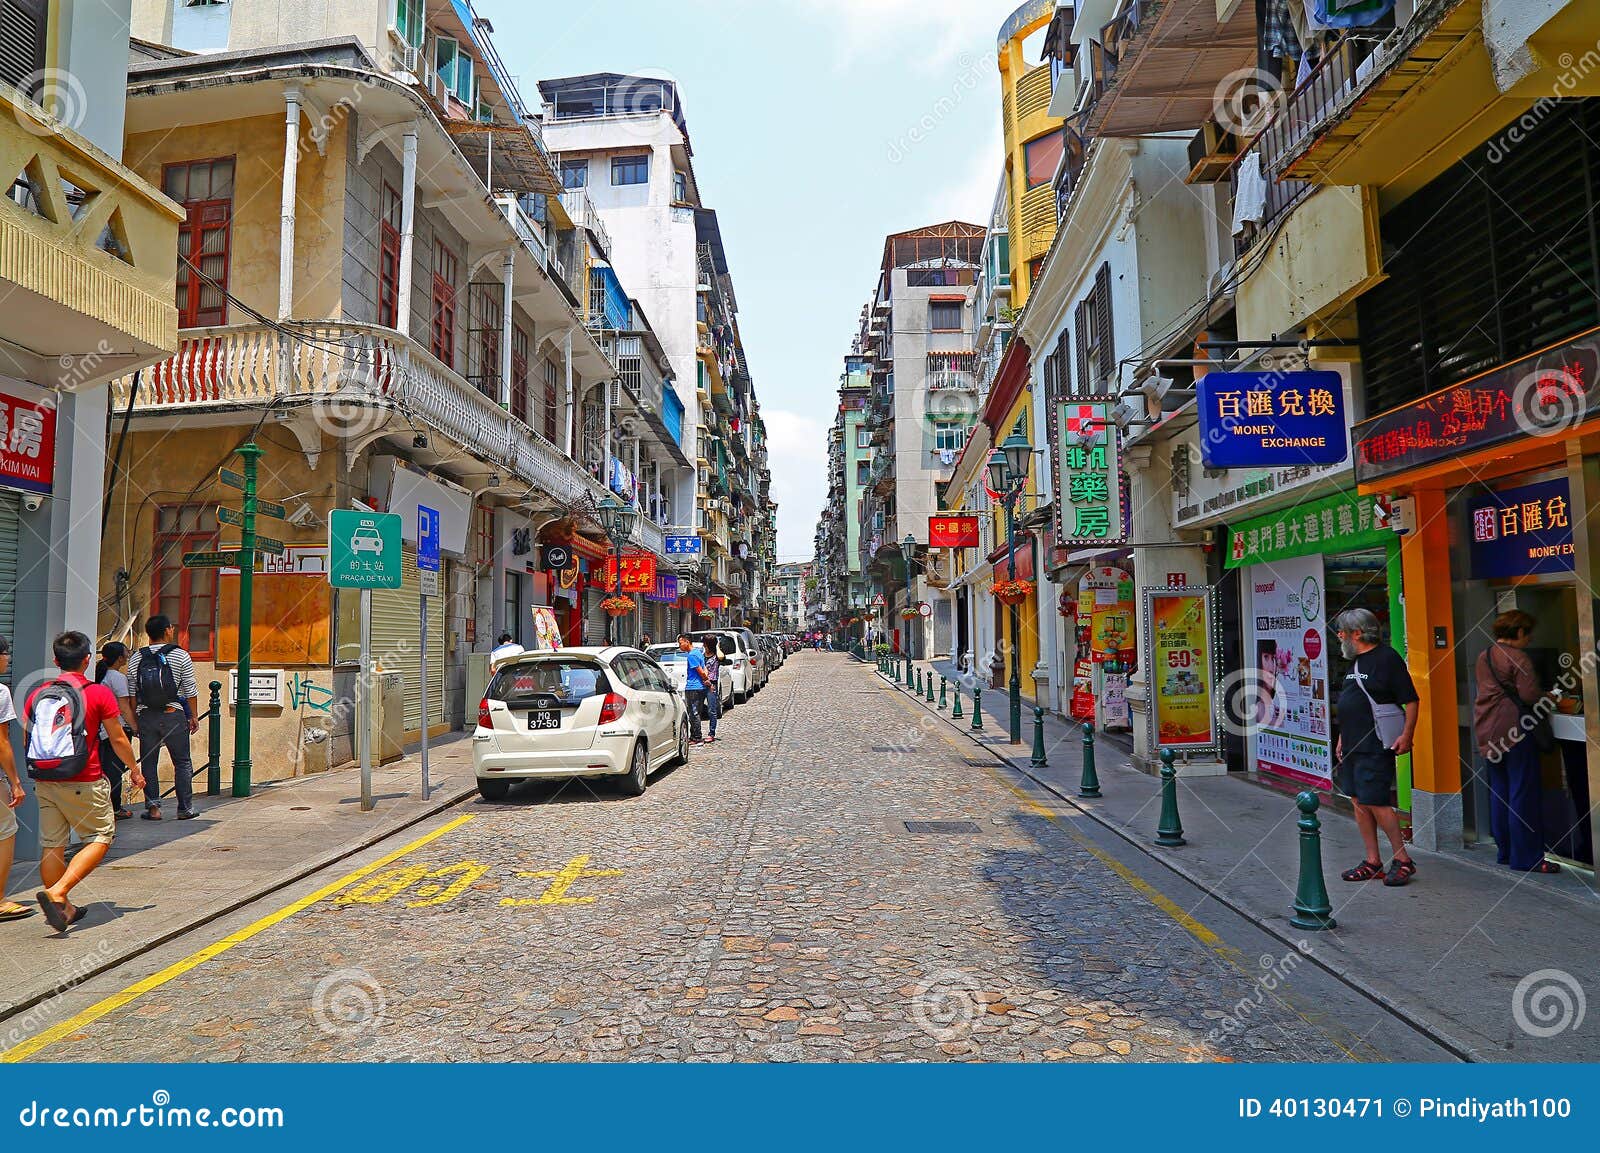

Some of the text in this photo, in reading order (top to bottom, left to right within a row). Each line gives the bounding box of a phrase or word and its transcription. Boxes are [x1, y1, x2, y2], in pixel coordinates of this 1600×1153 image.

[1215, 388, 1335, 417] 百匯兌換
[1233, 425, 1275, 435] MONEY
[1261, 437, 1326, 448] EXCHANGE
[0, 459, 40, 478] KIM WAI
[1529, 545, 1561, 559] MONEY
[350, 560, 384, 572] 的士站
[340, 574, 365, 584] PRAÇA
[538, 712, 551, 720] MQ
[530, 719, 559, 729] 37-50
